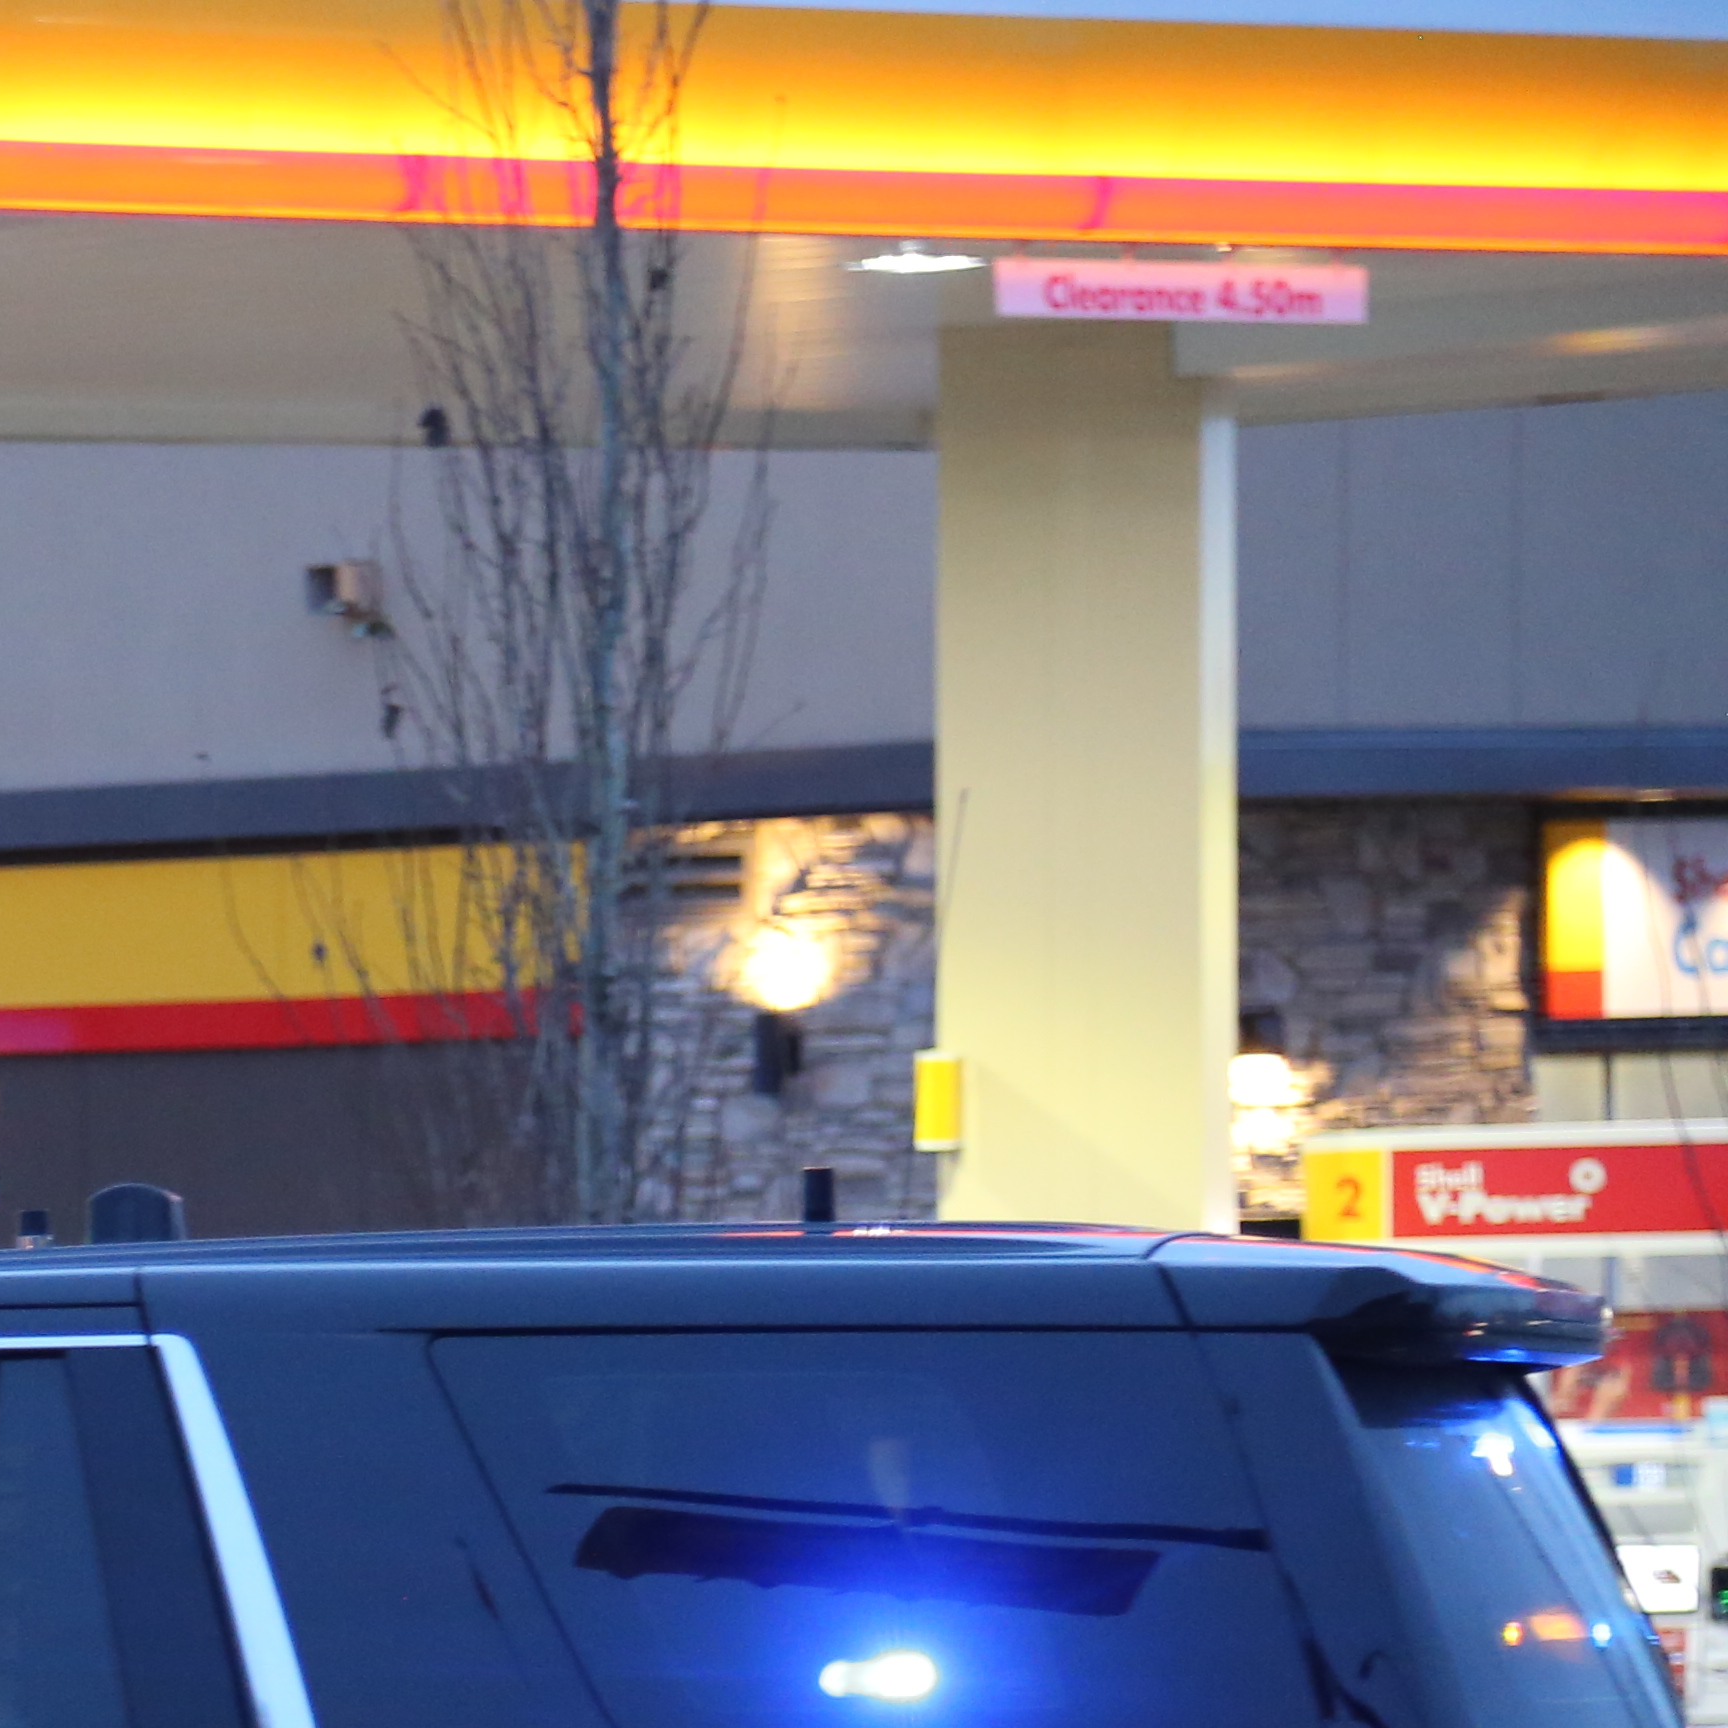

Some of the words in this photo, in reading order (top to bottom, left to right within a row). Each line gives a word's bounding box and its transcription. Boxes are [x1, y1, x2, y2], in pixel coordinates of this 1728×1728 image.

[1045, 272, 1206, 315] Clearance
[1215, 277, 1325, 317] 4.50m
[1333, 1176, 1363, 1219] 2
[1415, 1190, 1594, 1226] V-Power
